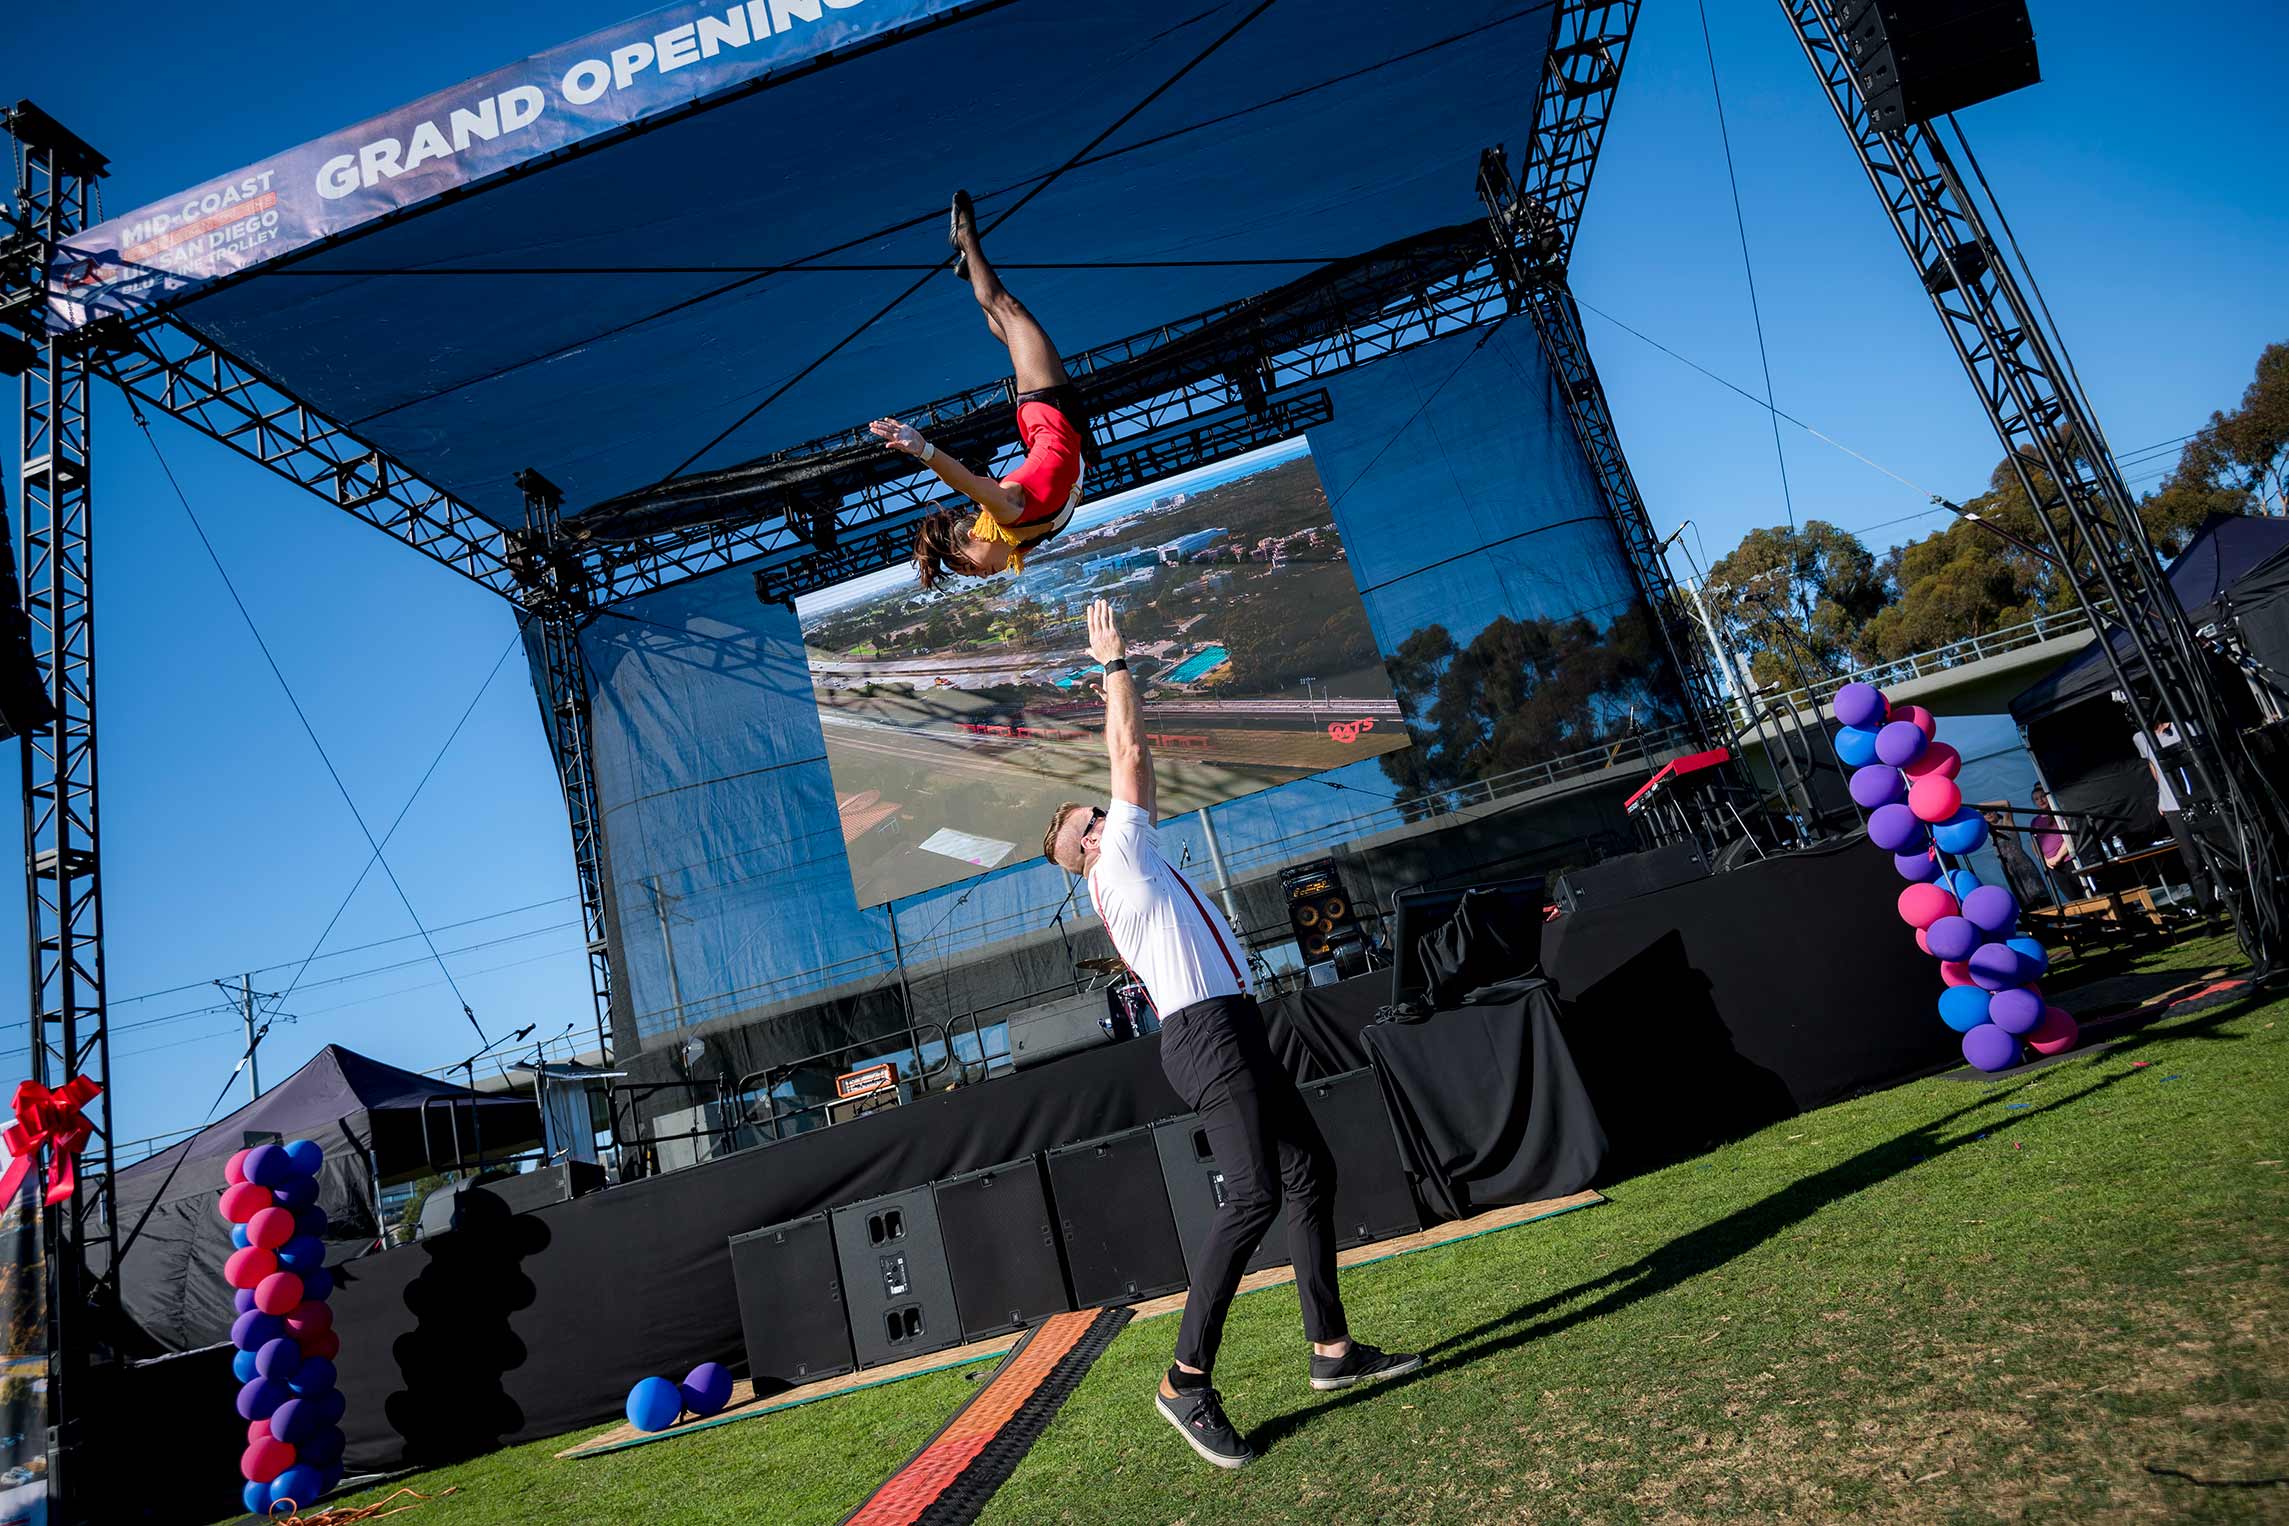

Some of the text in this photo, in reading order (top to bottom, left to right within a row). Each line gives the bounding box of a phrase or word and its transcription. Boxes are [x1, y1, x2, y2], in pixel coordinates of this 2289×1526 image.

[315, 0, 864, 200] GRAND OPENIN
[122, 170, 274, 247] MID-COAST
[159, 239, 205, 269] SAN
[208, 210, 279, 249] DIEGO
[207, 227, 279, 263] TROLLEY
